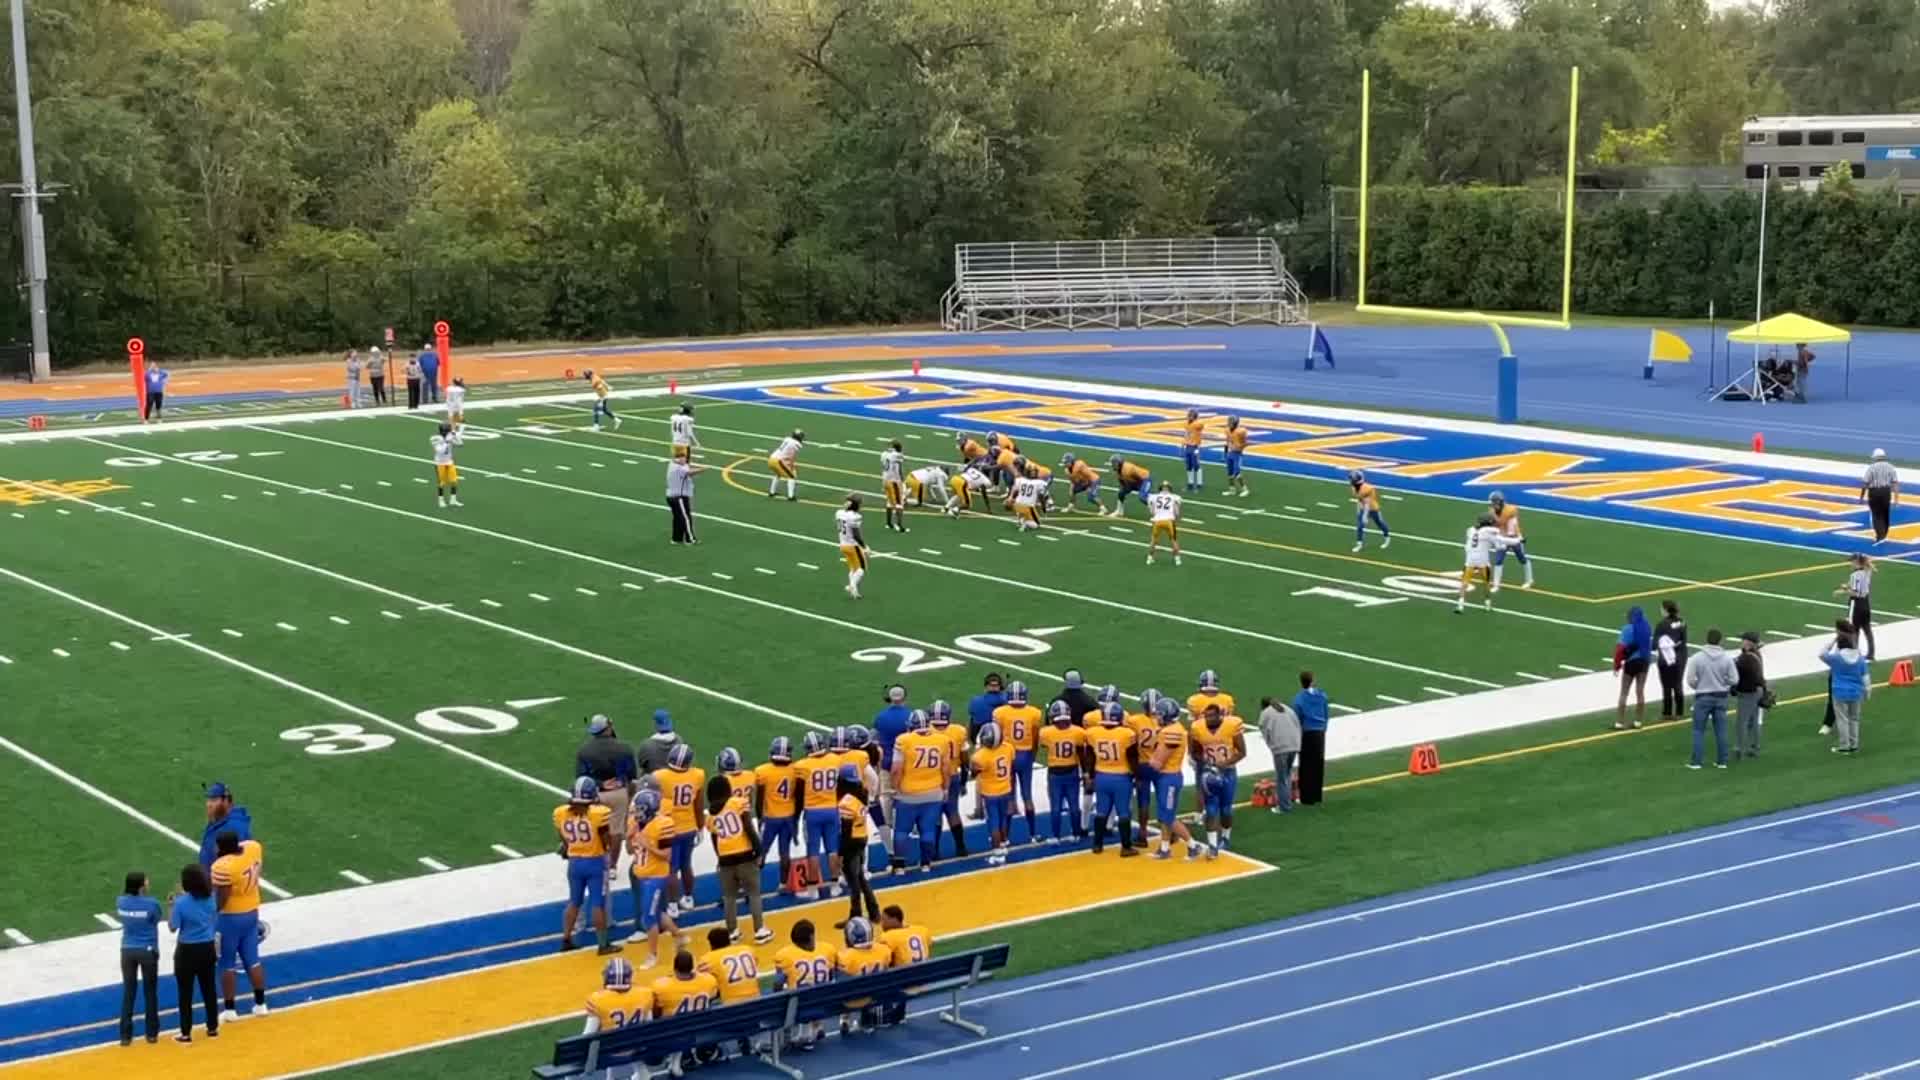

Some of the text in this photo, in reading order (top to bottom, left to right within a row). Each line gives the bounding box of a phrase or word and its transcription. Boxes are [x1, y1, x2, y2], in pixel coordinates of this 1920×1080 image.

[762, 381, 1920, 544] STEELME
[1156, 496, 1171, 510] 52
[850, 633, 1052, 673] 20
[279, 706, 519, 754] 30
[1012, 720, 1024, 741] 6
[914, 748, 938, 769] 76
[1055, 741, 1073, 759] 18
[1098, 741, 1119, 761] 51
[1418, 749, 1437, 770] 20
[996, 757, 1007, 778] 5
[777, 778, 789, 799] 4
[812, 769, 836, 792] 88
[673, 784, 692, 806] 16
[563, 820, 592, 843] 99
[713, 811, 740, 839] 30
[909, 936, 923, 962] 9
[723, 952, 757, 984] 20
[795, 958, 827, 988] 26
